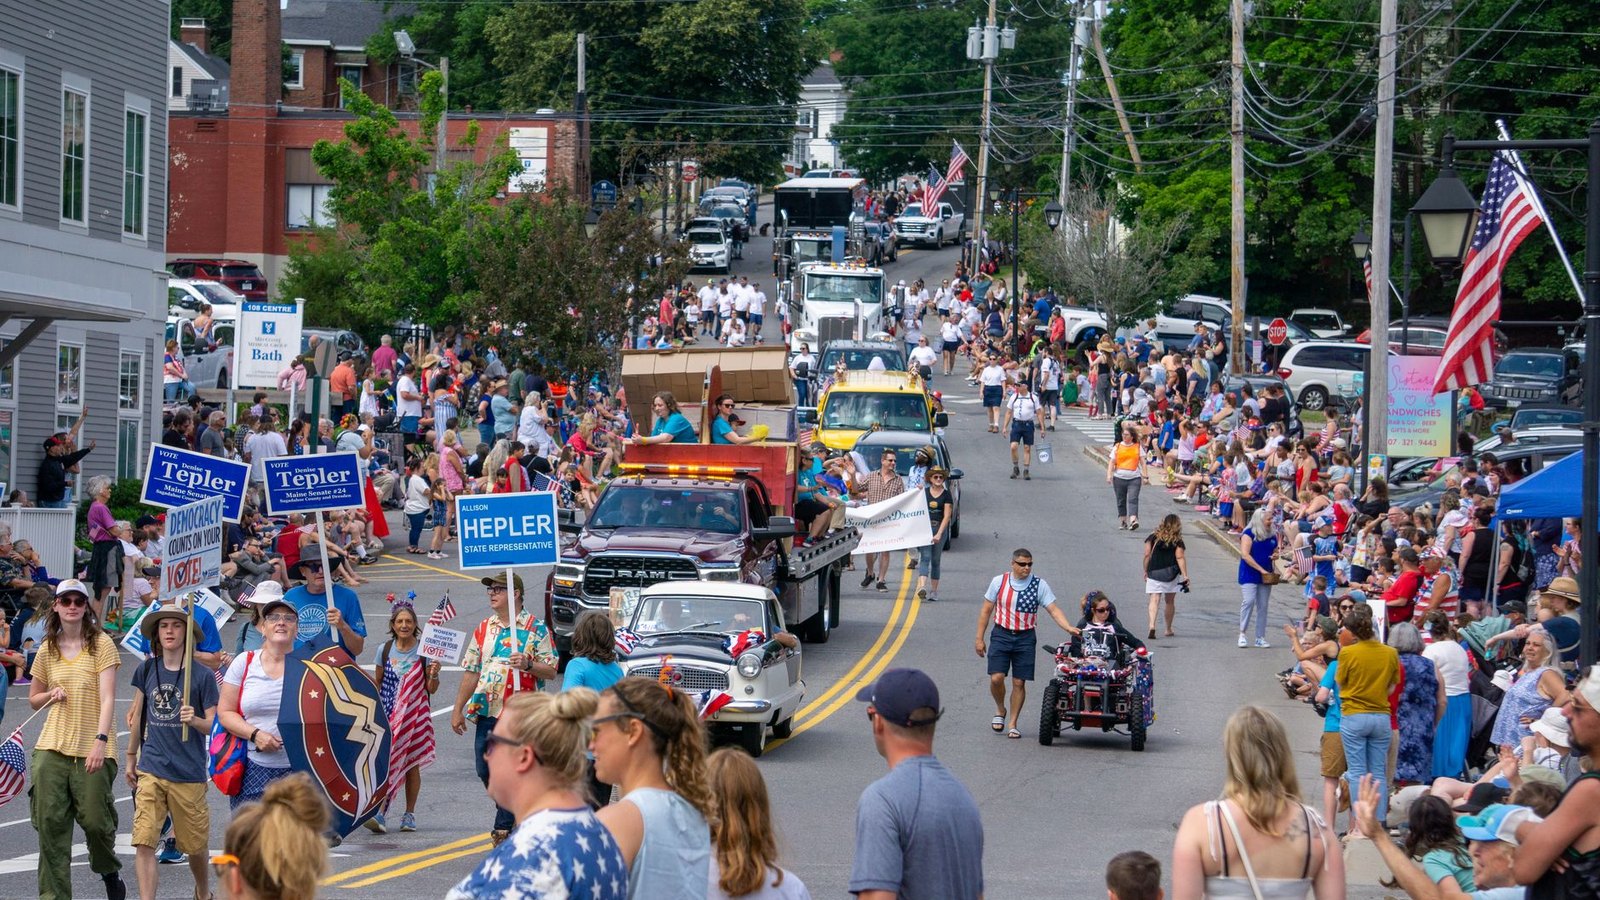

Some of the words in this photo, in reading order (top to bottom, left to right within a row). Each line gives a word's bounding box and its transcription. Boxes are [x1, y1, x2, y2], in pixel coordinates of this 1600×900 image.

[1270, 327, 1286, 337] STOP
[252, 348, 282, 360] Bath
[1387, 408, 1441, 417] ANDWICHES
[160, 450, 178, 460] VOTE
[182, 462, 204, 472] Denise
[162, 461, 236, 492] Tepler
[276, 468, 350, 490] Tepler
[164, 484, 186, 494] Maine
[170, 500, 222, 536] DEMOCRACY
[464, 514, 552, 539] HEPLER
[168, 534, 192, 556] COUNTS
[192, 532, 202, 548] ON
[203, 526, 220, 546] YOUR
[464, 545, 486, 553] STATE
[489, 541, 553, 552] REPRESENTATIVE
[167, 557, 202, 592] VOTE!
[617, 570, 666, 578] RAM
[433, 628, 457, 638] WOMEN'S
[425, 637, 441, 646] COUNTS
